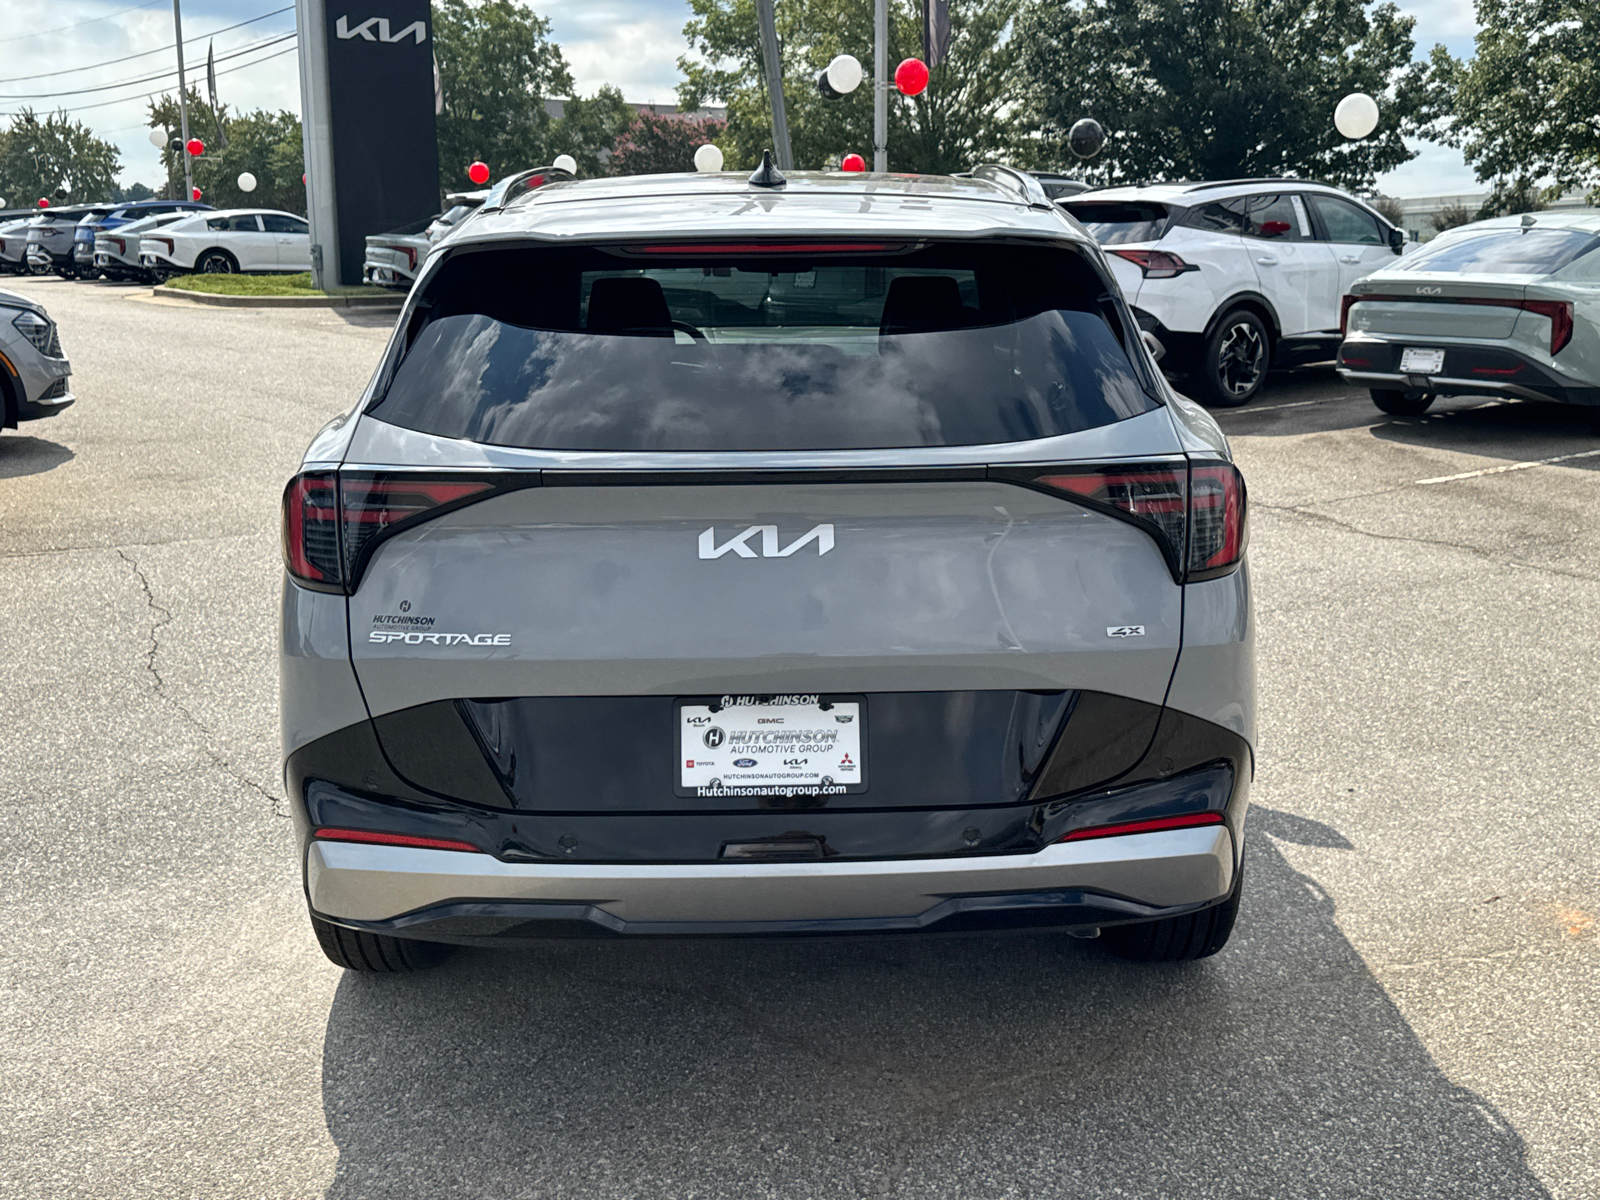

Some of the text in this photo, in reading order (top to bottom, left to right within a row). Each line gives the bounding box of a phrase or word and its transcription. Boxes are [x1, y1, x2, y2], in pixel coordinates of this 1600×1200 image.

[336, 15, 426, 45] KIA
[698, 524, 835, 559] KIA
[372, 614, 436, 626] HUTCHINSON
[1109, 626, 1142, 637] 4X
[368, 631, 512, 646] SPORTAGE
[736, 694, 820, 706] HUHINSON
[728, 729, 838, 745] HUTCHINSON
[730, 744, 834, 754] AUTOMOTIVE GROUP
[737, 759, 754, 767] Ford
[697, 785, 847, 797] Hutchinsonautogroup.com
